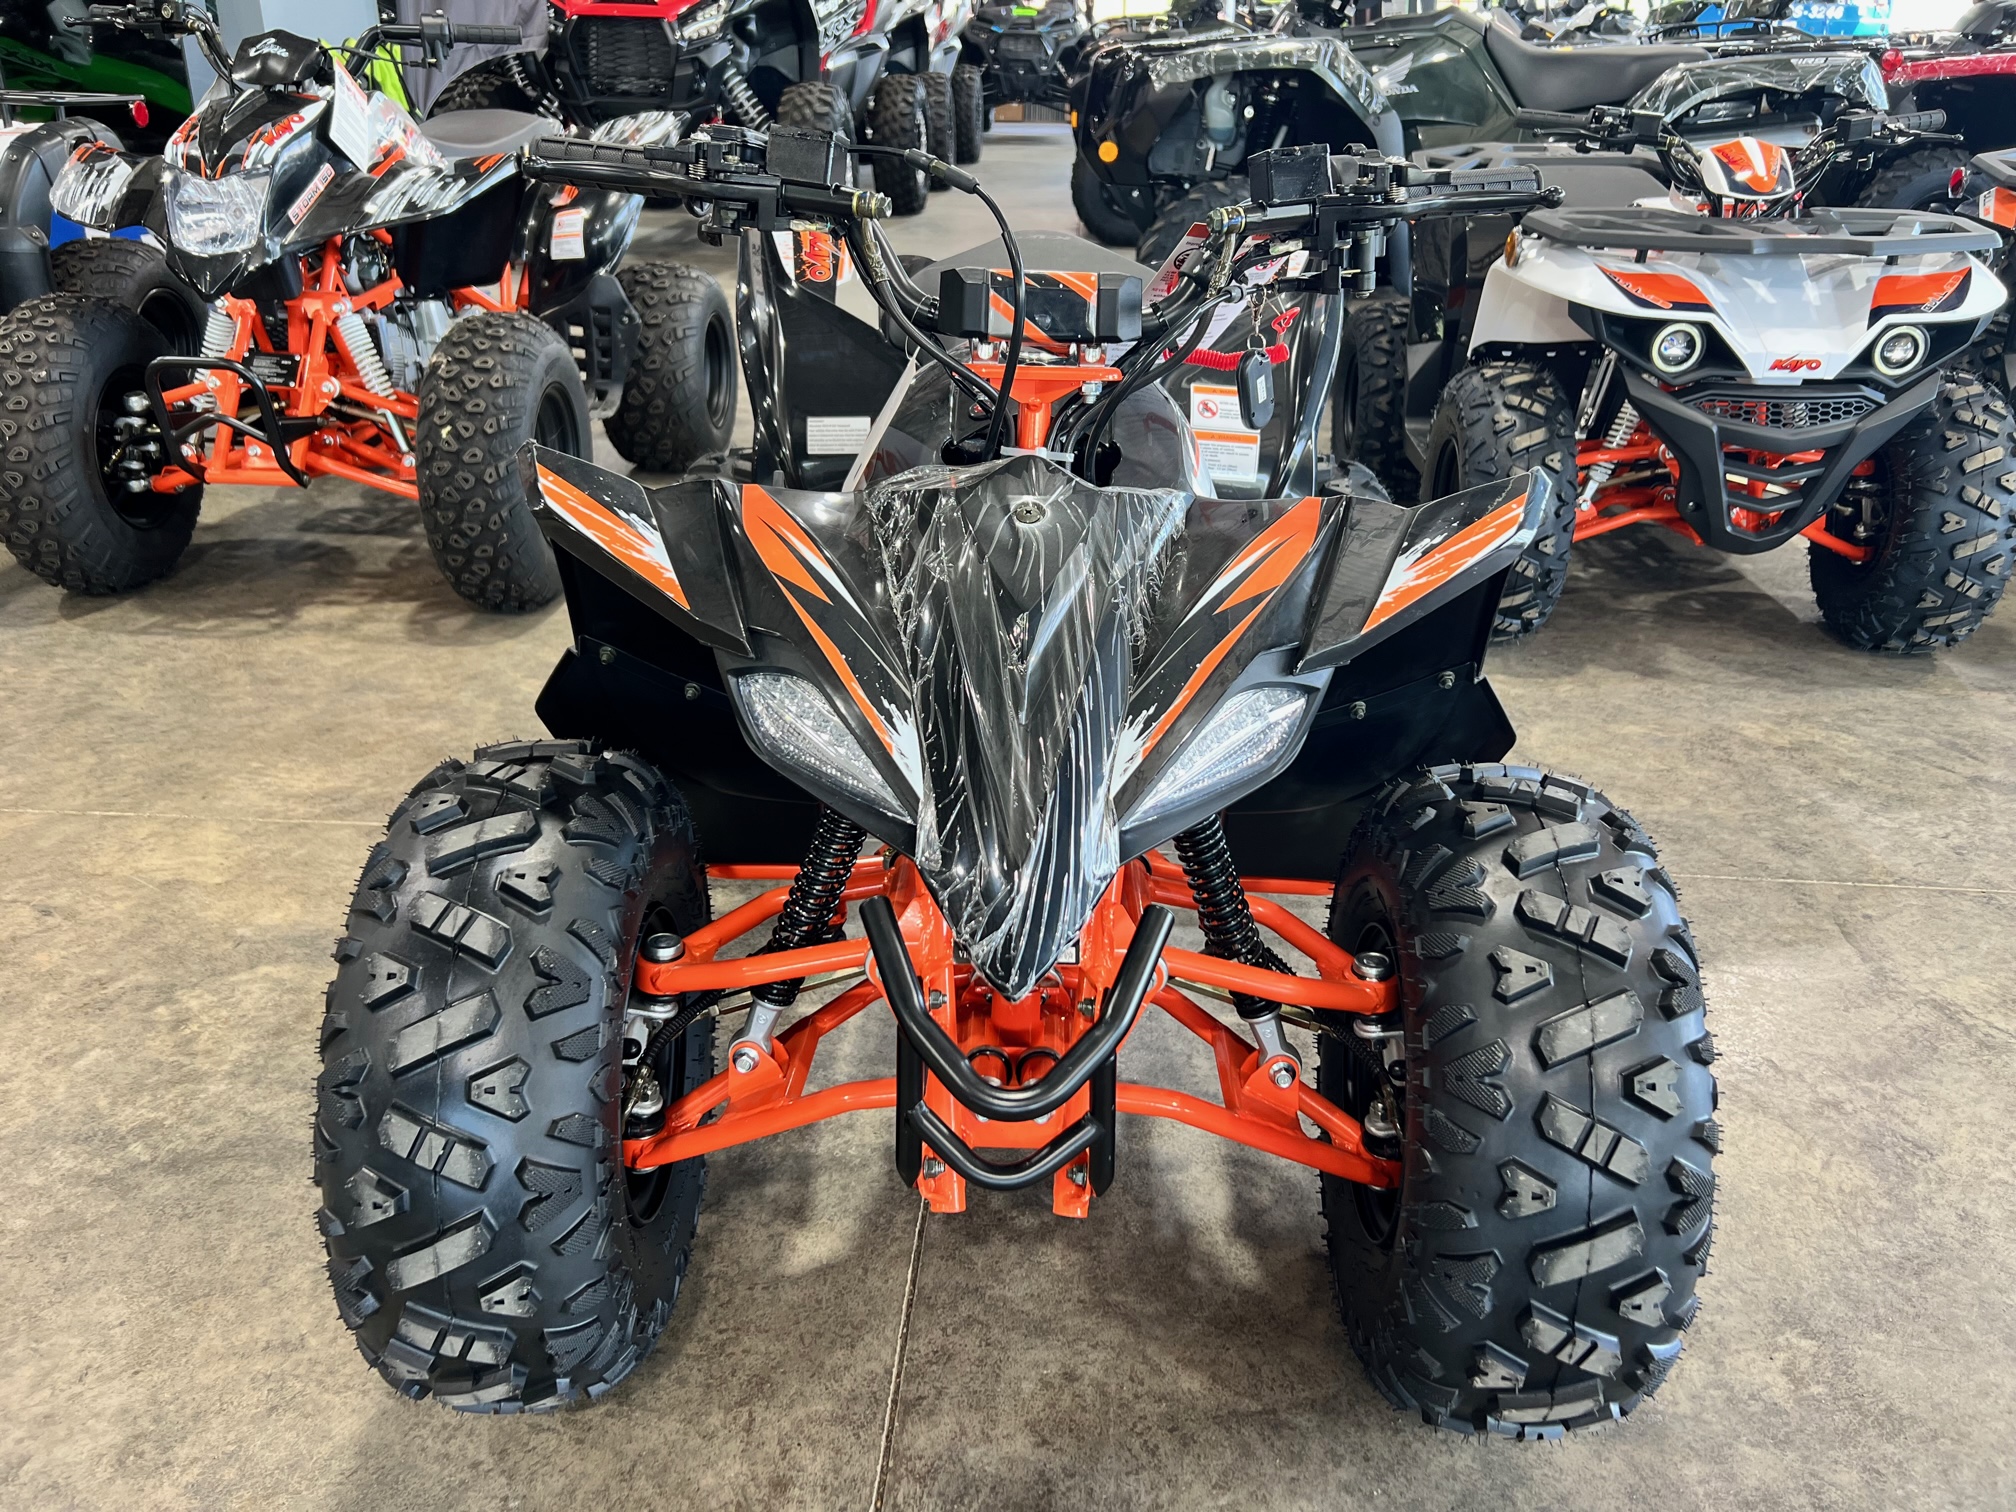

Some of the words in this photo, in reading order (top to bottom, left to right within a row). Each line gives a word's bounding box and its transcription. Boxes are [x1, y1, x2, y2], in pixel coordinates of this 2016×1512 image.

[1379, 84, 1419, 96] ONDA
[261, 113, 305, 146] KAYO
[291, 184, 321, 221] STORM
[319, 168, 333, 188] 150
[804, 231, 833, 282] KAYO
[1768, 353, 1822, 373] KAYO
